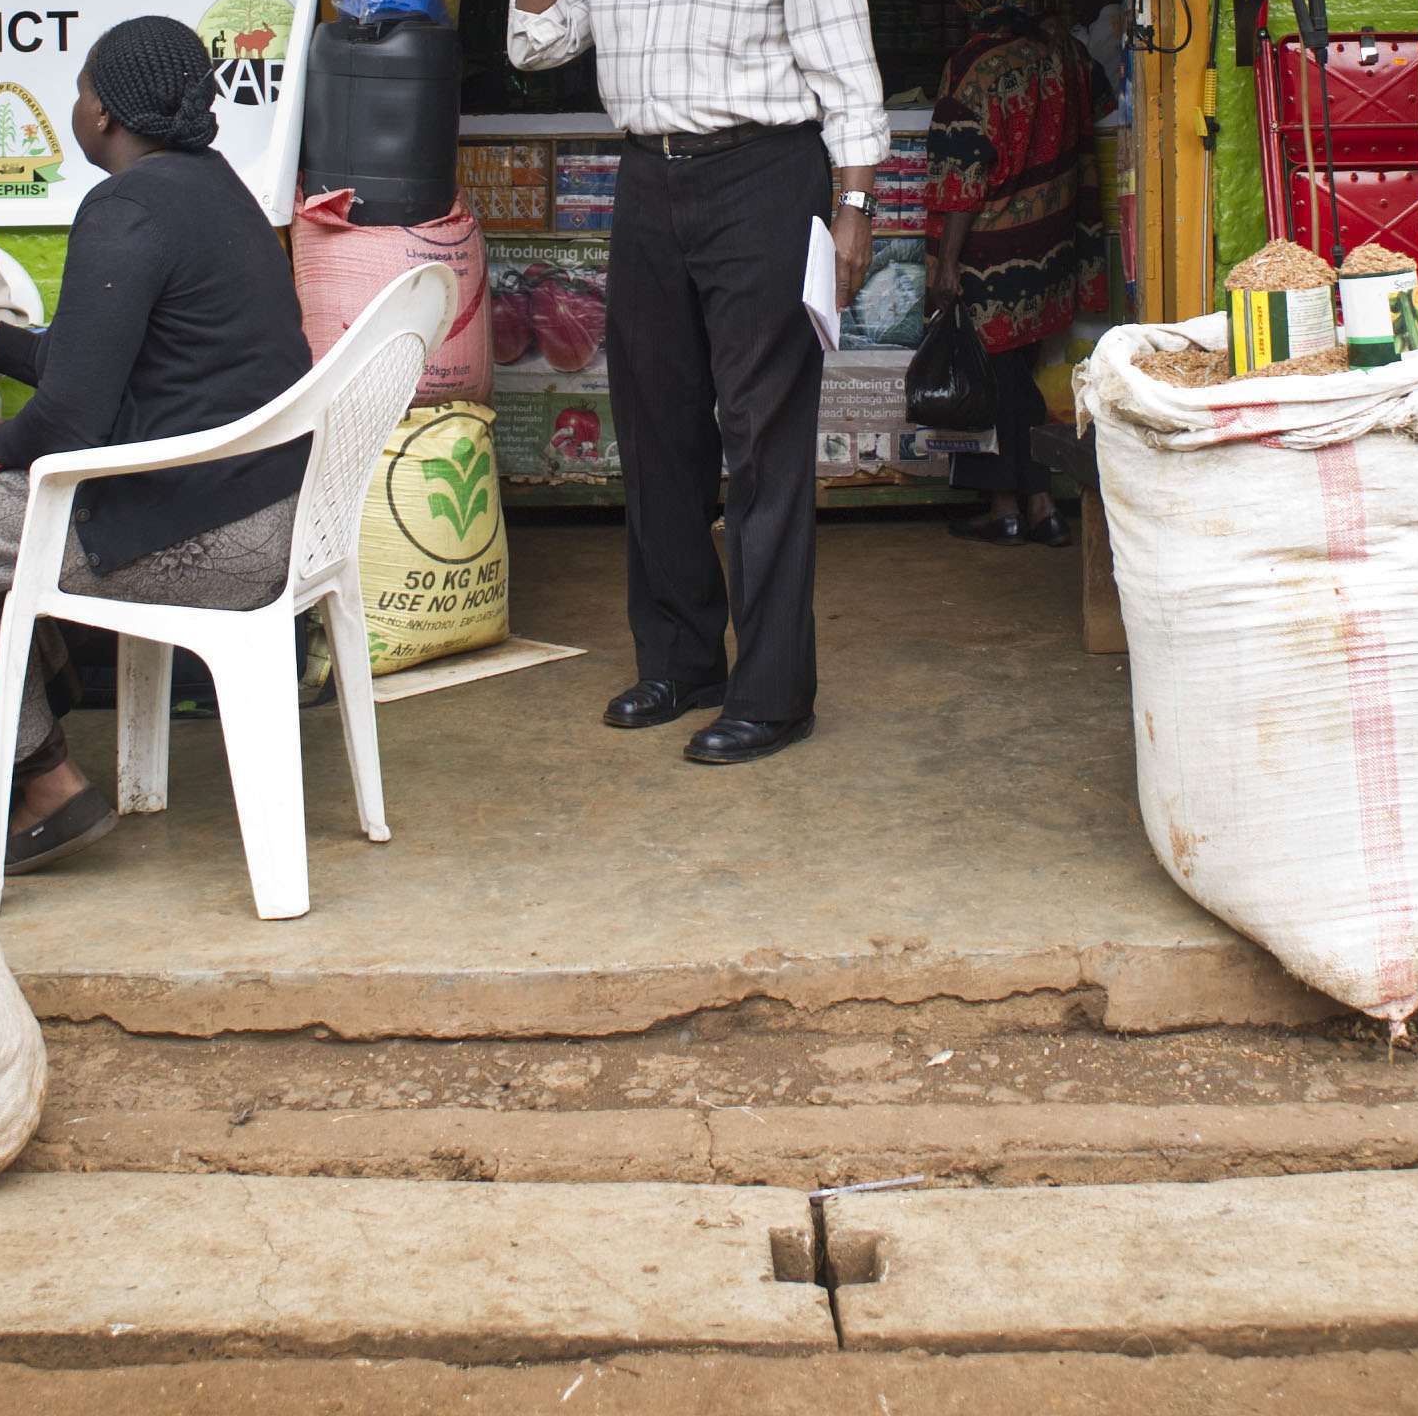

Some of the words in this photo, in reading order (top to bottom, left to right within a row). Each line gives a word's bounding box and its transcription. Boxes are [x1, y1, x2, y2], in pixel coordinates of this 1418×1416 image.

[41, 119, 61, 154] SERVICE
[487, 244, 578, 261] Introducing
[583, 247, 610, 260] Kile
[821, 379, 891, 392] ntroducing
[821, 395, 833, 404] he
[837, 394, 882, 406] cabbage
[885, 395, 906, 404] with
[847, 408, 860, 418] for
[863, 407, 905, 419] busines
[404, 571, 435, 590] 50
[442, 568, 471, 591] KG
[477, 559, 502, 585] NET
[378, 591, 425, 612] USE
[427, 594, 457, 613] NO
[462, 582, 507, 610] HOOKS
